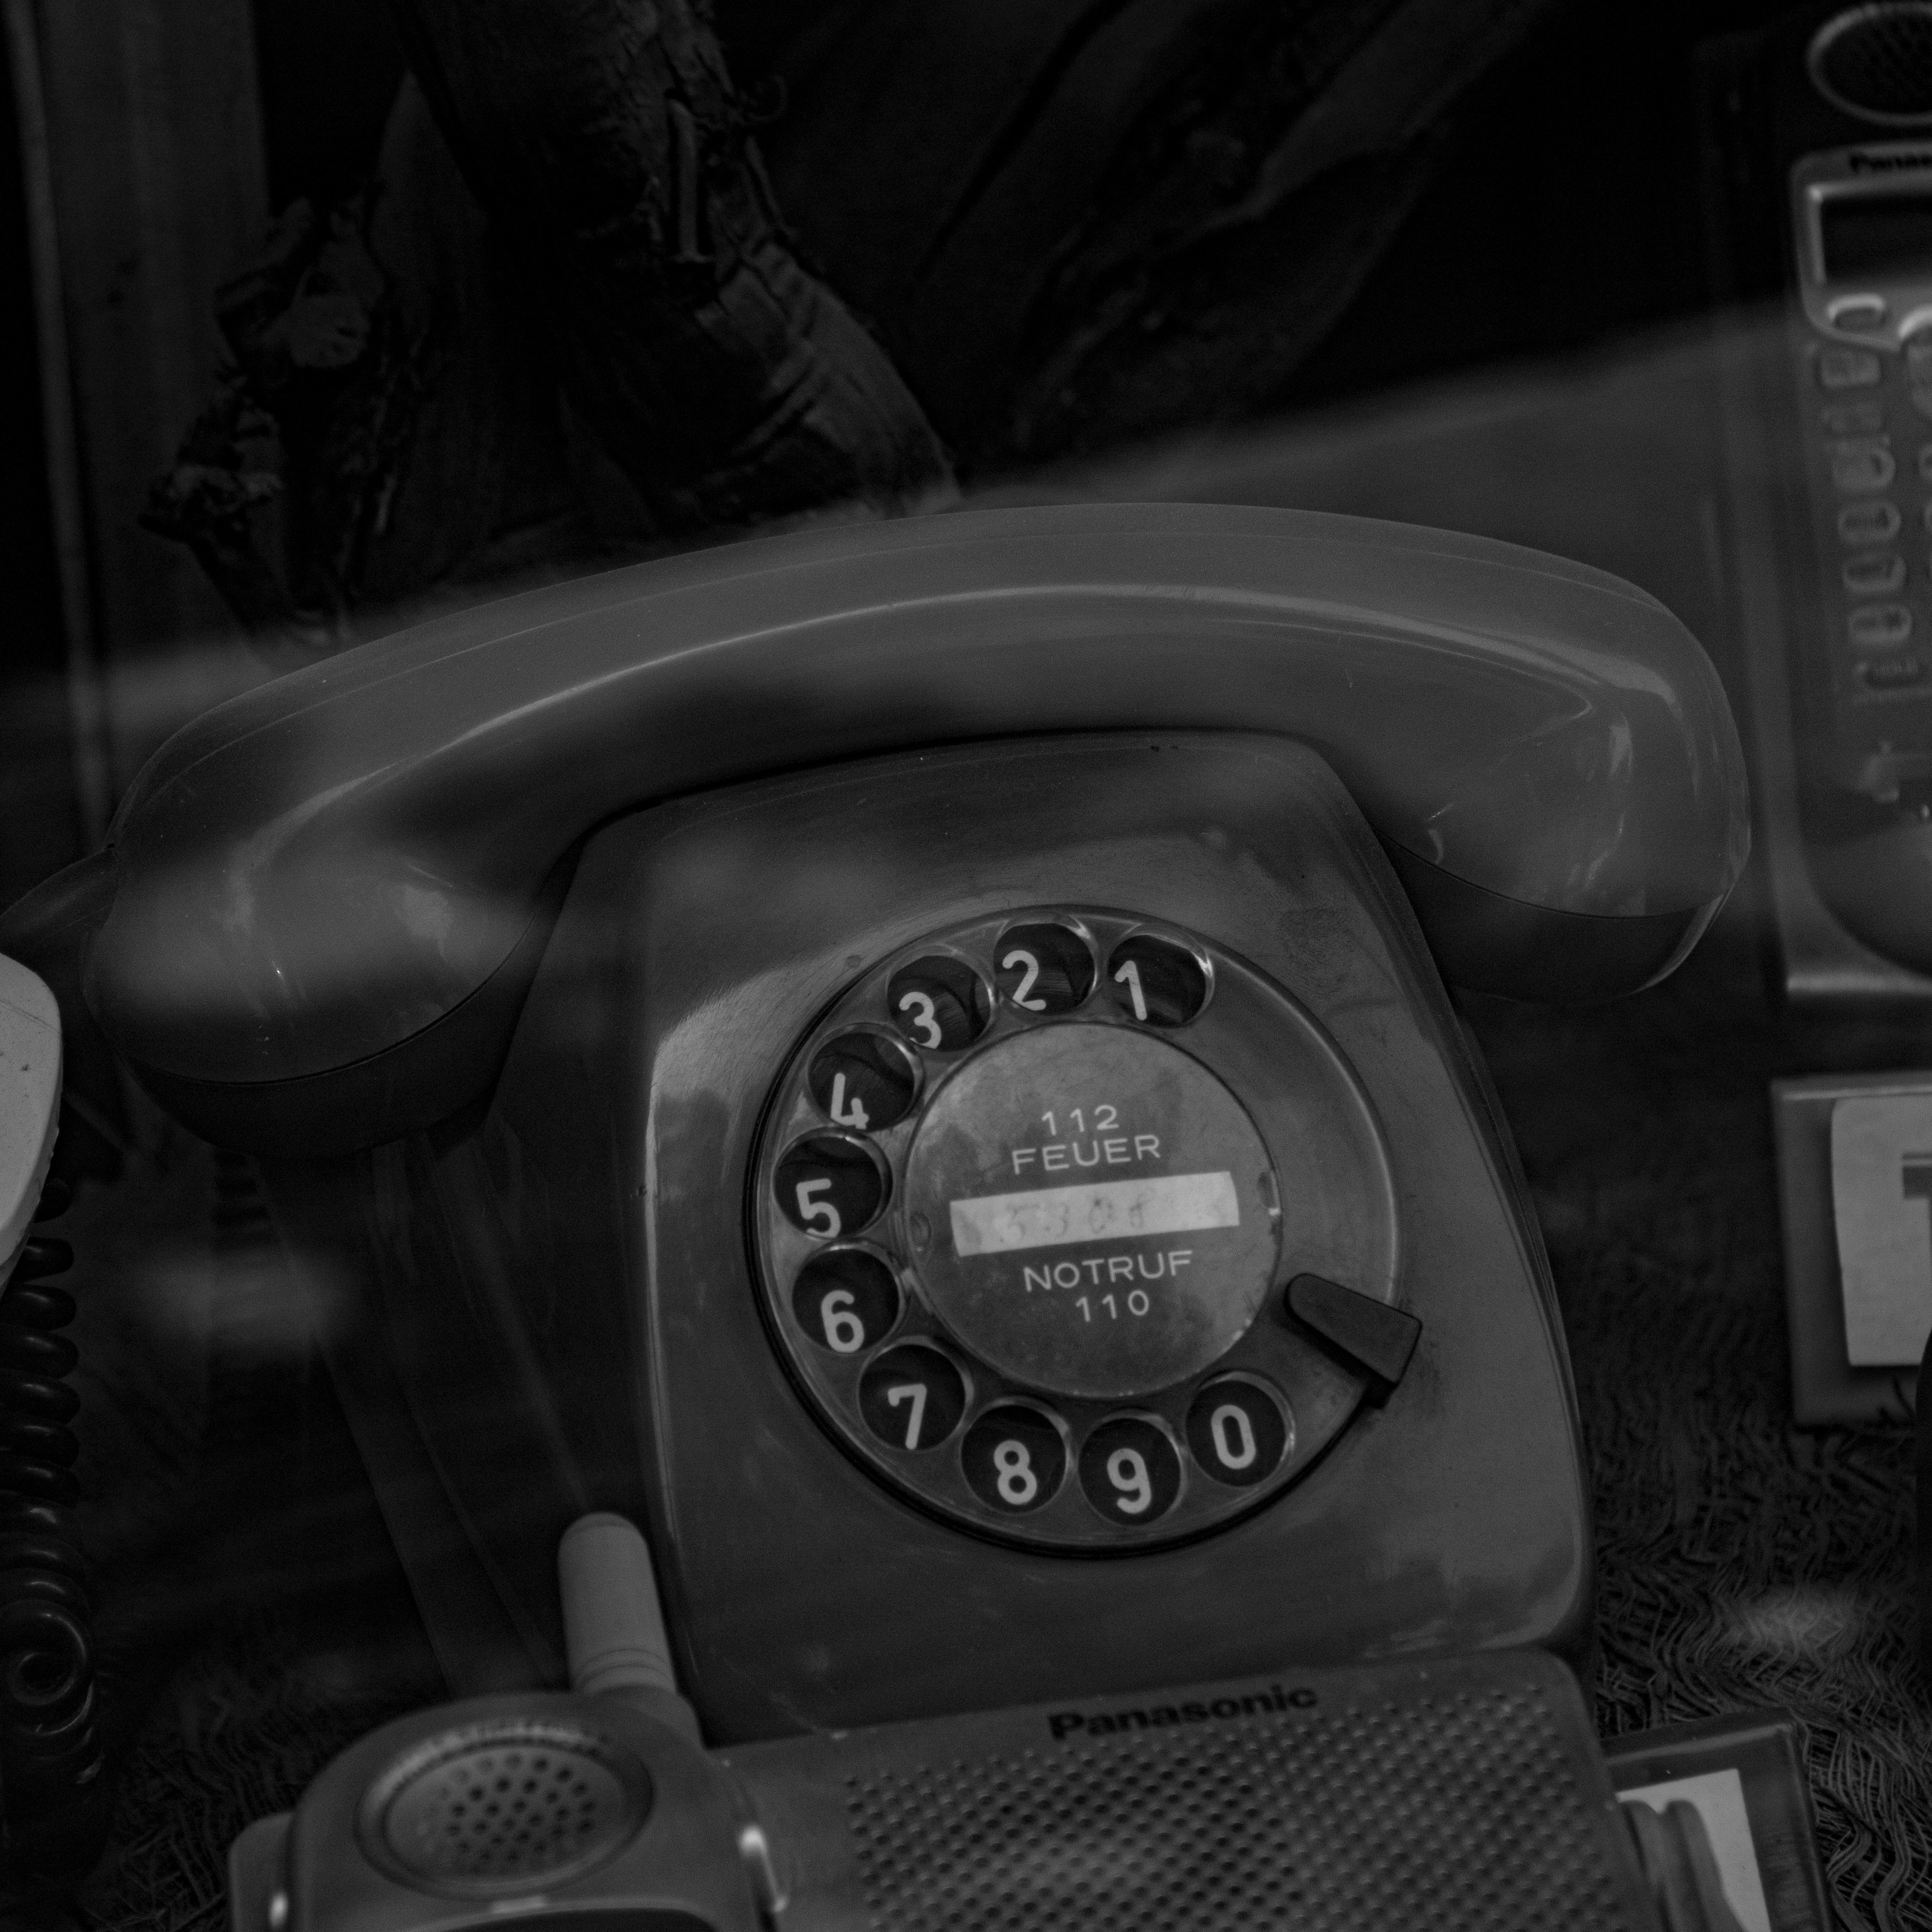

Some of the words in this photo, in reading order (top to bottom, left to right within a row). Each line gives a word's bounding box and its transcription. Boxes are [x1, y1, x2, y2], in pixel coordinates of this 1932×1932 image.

[1003, 950, 1046, 1010] 2
[1115, 960, 1147, 1020] 1
[899, 991, 942, 1049] 3
[830, 1072, 869, 1130] 4
[1041, 1105, 1119, 1135] 112
[1012, 1134, 1161, 1174] FEUER
[796, 1178, 841, 1238] 5
[1023, 1250, 1193, 1293] NOTRUF
[821, 1290, 864, 1354] 6
[1075, 1289, 1150, 1323] 110
[888, 1383, 928, 1451] 7
[1211, 1405, 1257, 1470] 0
[993, 1439, 1038, 1505] 8
[1106, 1447, 1152, 1515] 9
[1048, 1684, 1318, 1741] Panasonic
